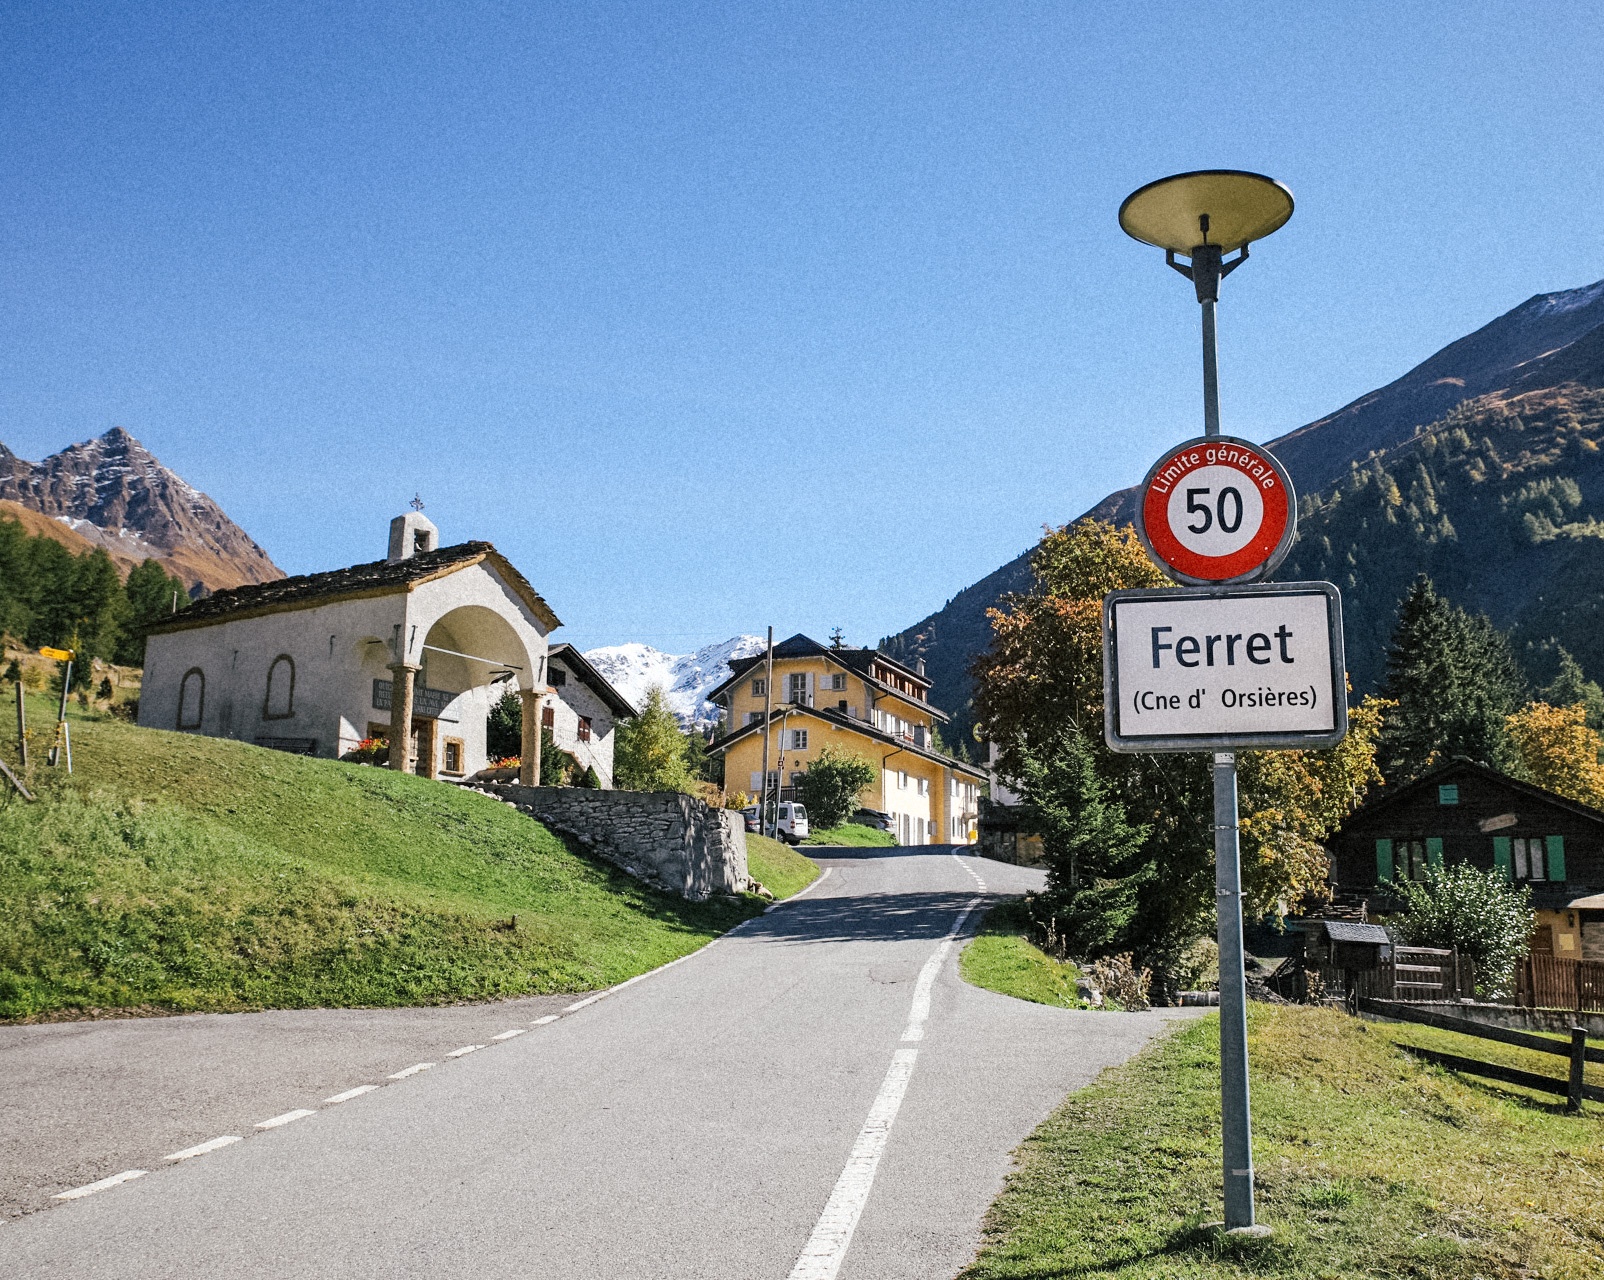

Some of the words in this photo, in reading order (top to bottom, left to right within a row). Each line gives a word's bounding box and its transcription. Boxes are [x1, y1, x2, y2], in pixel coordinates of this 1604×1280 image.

[1152, 452, 1201, 495] Limite
[1206, 447, 1274, 489] générale
[1186, 486, 1244, 534] 50
[1151, 624, 1295, 669] Ferret
[1133, 690, 1182, 714] (Cne
[1188, 688, 1206, 710] d'
[1221, 685, 1317, 709] Orsières)
